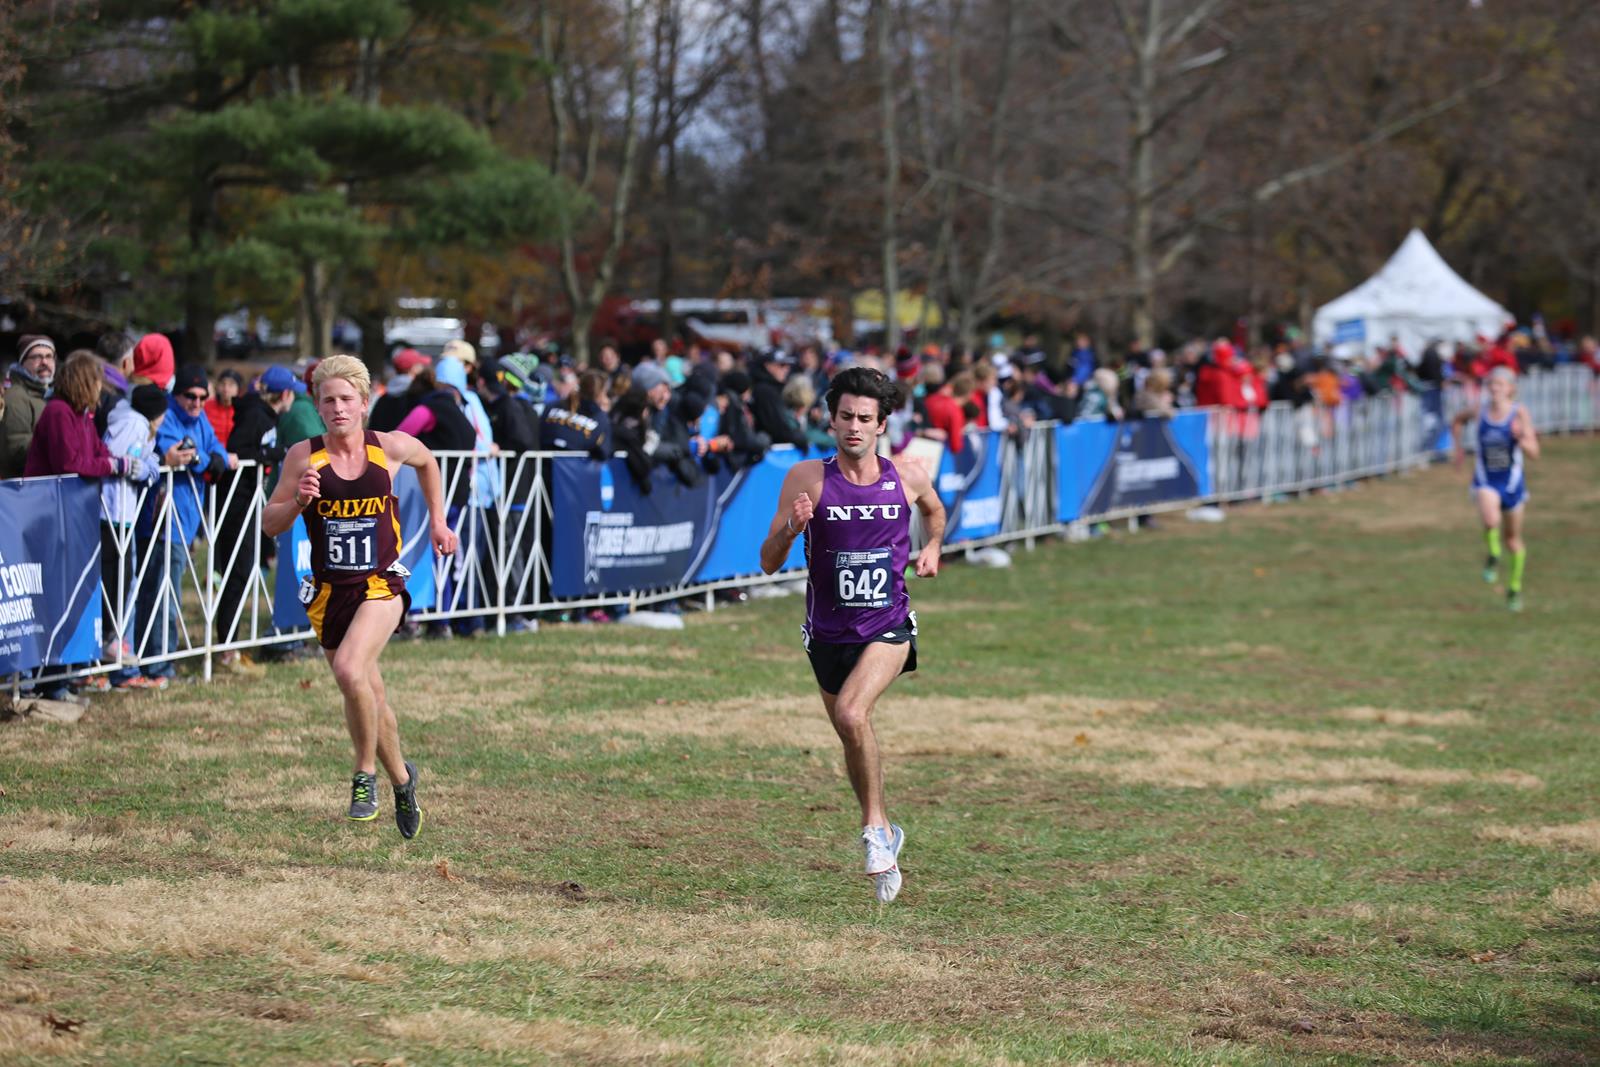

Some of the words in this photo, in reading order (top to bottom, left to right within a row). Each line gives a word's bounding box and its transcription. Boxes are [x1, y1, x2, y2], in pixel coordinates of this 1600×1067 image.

[318, 496, 388, 517] CALVIN
[827, 505, 901, 520] NYU
[329, 536, 371, 563] 511
[838, 568, 888, 600] 642
